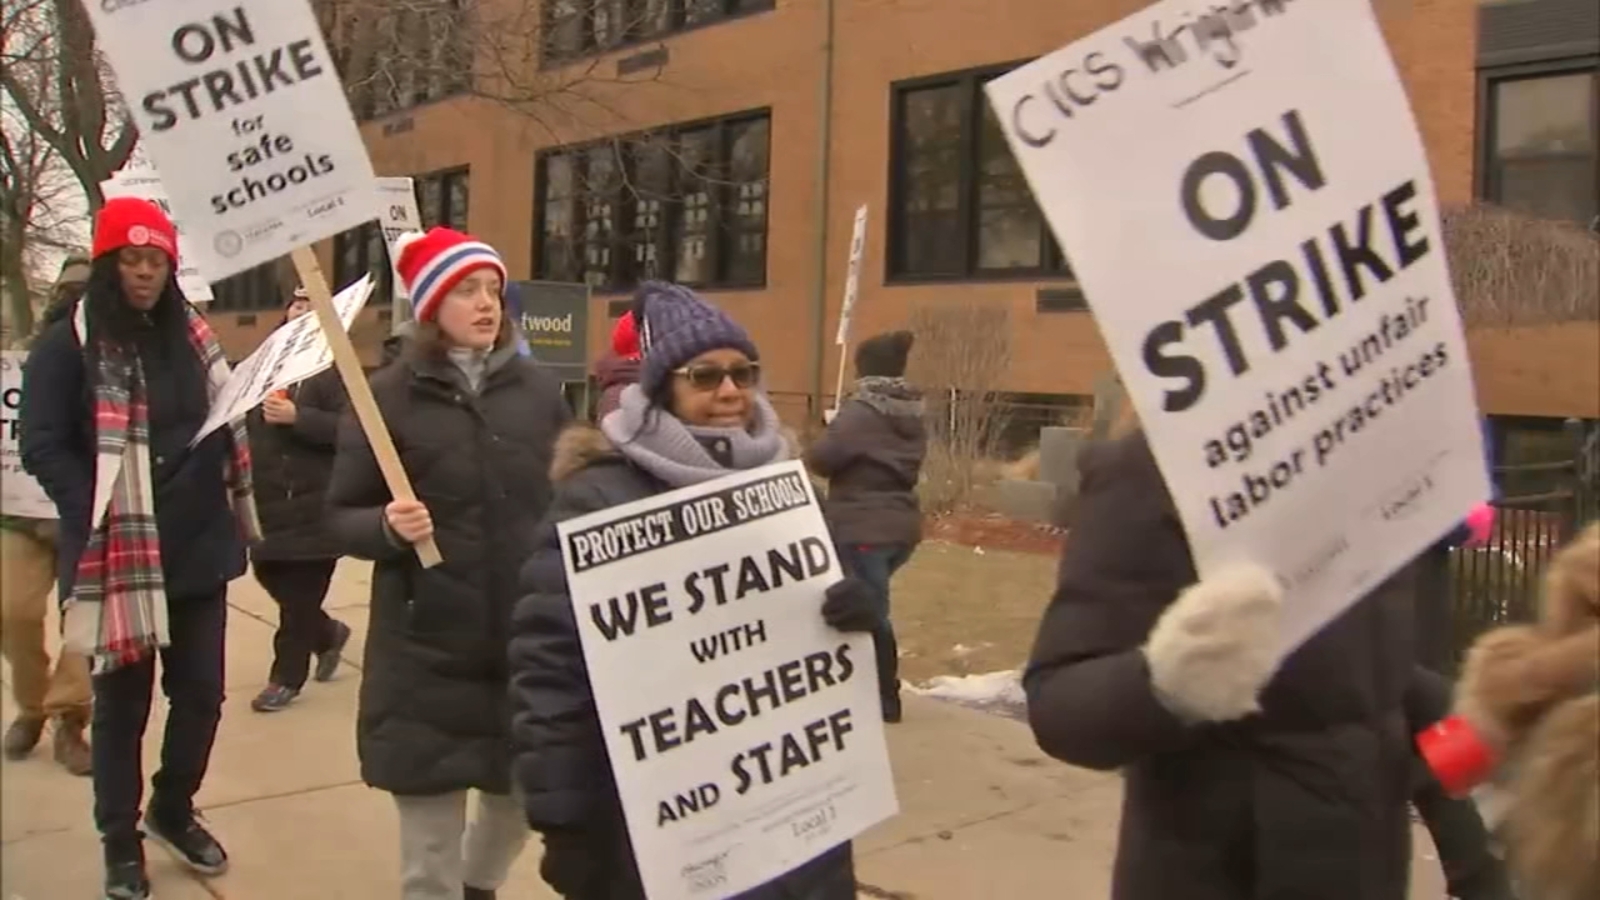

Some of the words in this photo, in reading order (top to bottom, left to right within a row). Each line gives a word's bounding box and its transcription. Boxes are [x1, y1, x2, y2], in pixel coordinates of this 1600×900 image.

[171, 6, 255, 63] ON
[142, 39, 324, 131] STRIKE
[231, 112, 265, 138] for
[1012, 52, 1125, 148] CICS
[210, 151, 335, 215] schools
[227, 131, 294, 173] safe
[1179, 108, 1327, 241] ON
[389, 204, 408, 221] ON
[521, 311, 572, 332] twood
[1142, 180, 1431, 413] STRIKE
[1202, 361, 1337, 470] against
[1339, 296, 1430, 378] unfair
[1208, 448, 1305, 529] labor
[1312, 341, 1449, 466] practices
[571, 512, 675, 568] PROTECT
[681, 496, 730, 536] OUR
[732, 474, 808, 521] SCHOOLS
[589, 582, 672, 642] WE
[684, 535, 831, 615] STAND
[690, 619, 767, 663] WITH
[620, 644, 854, 762] TEACHERS
[657, 782, 721, 827] AND
[730, 708, 854, 795] STAFF
[790, 808, 827, 838] Local
